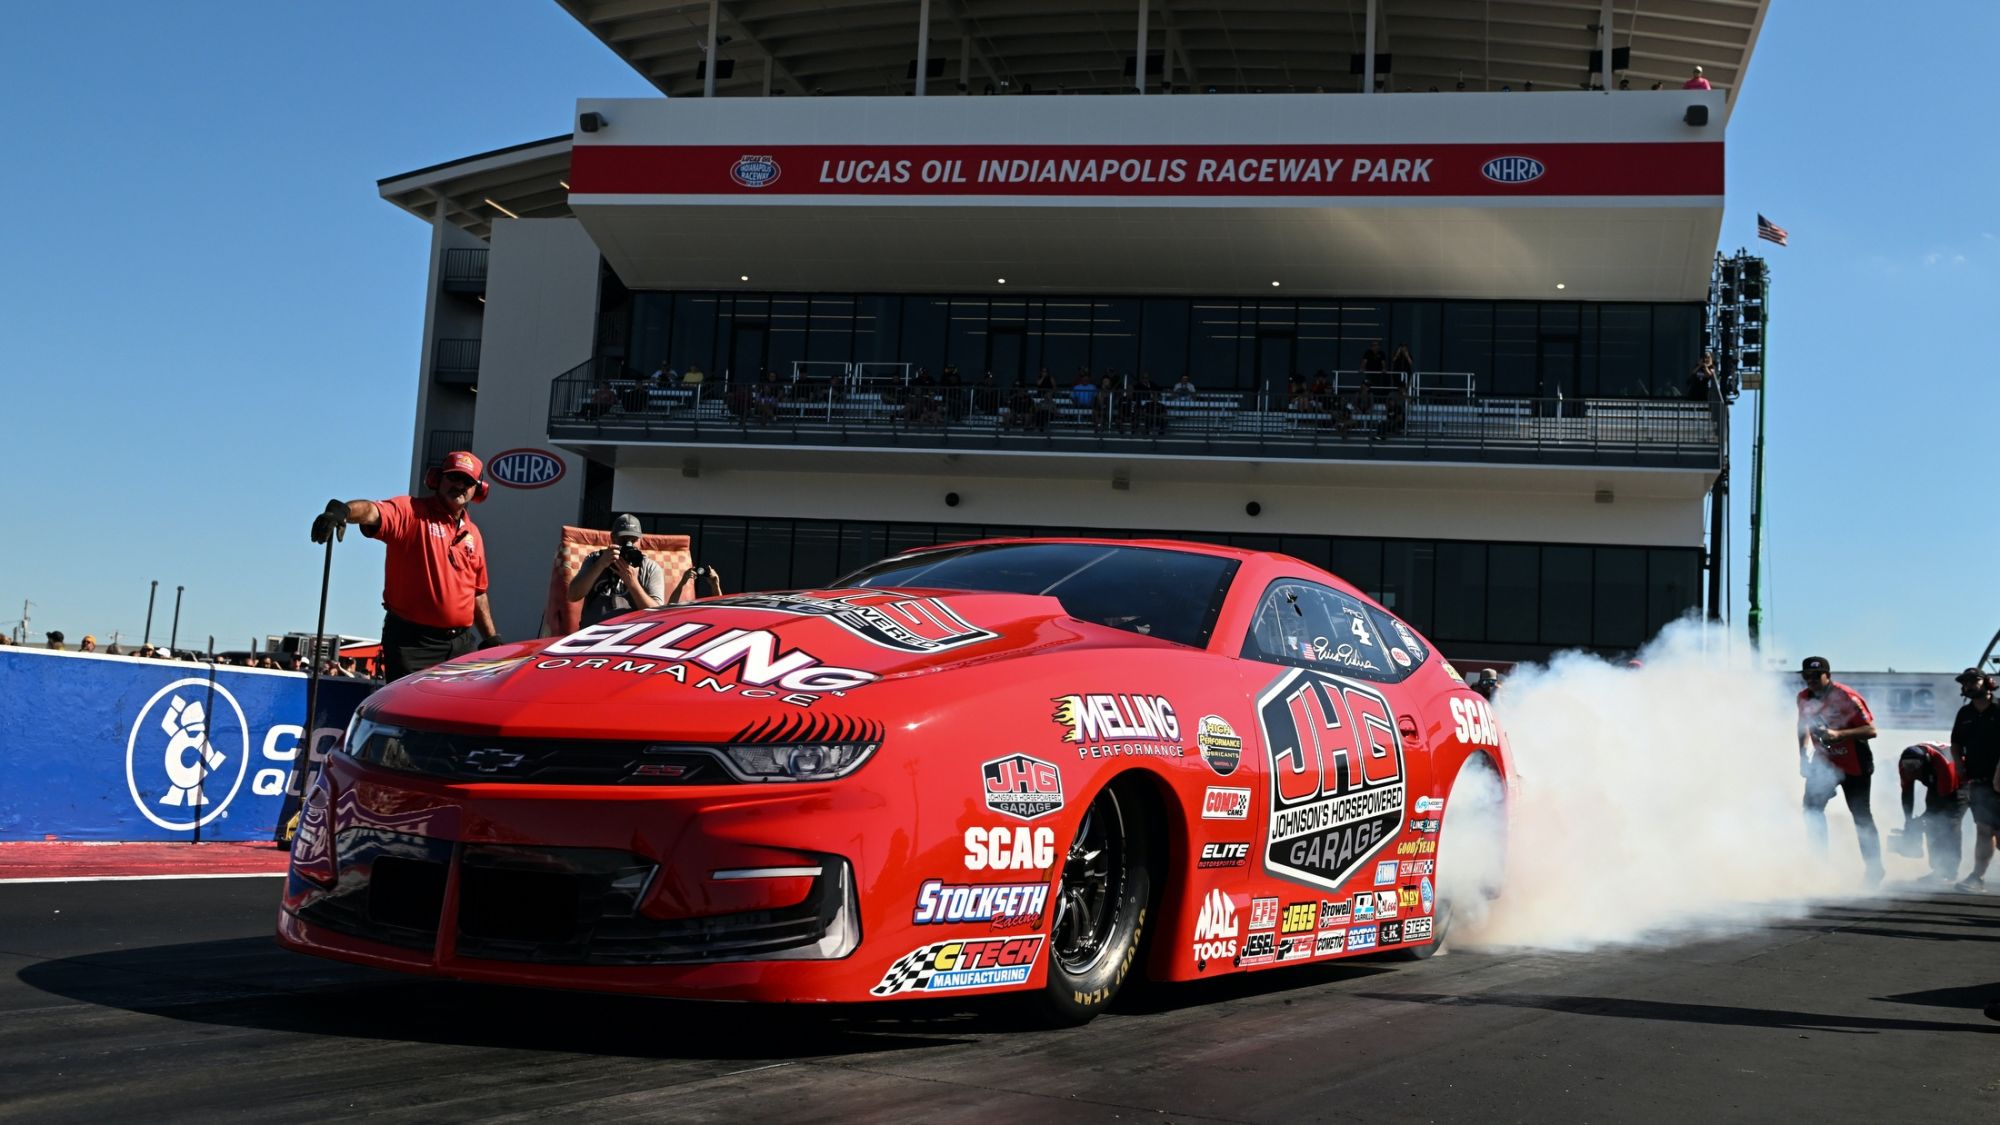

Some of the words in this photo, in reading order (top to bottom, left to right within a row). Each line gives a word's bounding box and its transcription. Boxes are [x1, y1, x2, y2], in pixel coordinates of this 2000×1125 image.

[819, 159, 912, 184] LUCAS
[920, 159, 967, 184] OIL
[977, 158, 1187, 183] INDIANAPOLIS
[1196, 157, 1344, 183] RACEWAY
[1351, 157, 1434, 183] PARK
[1487, 161, 1541, 179] NHRA
[499, 455, 555, 482] NHRA
[1351, 618, 1373, 647] 4
[543, 621, 882, 692] ELLING
[1074, 694, 1181, 743] MELLING
[1206, 723, 1231, 735] HIGH
[1078, 743, 1185, 760] PERFORMANCE
[1200, 734, 1241, 748] PERFORMANCE
[1275, 681, 1400, 805] JHG
[986, 759, 1059, 793] JHG
[1000, 803, 1052, 815] GARAGE
[1020, 794, 1062, 802] HORSEPOWERED
[1206, 791, 1239, 813] COMP
[1272, 803, 1329, 840] JOHNSON'S
[1331, 786, 1403, 824] HORSEPOWERED
[964, 826, 1055, 871] SCAG
[1201, 844, 1250, 858] ELITE
[1290, 820, 1383, 870] GARAGE
[1397, 838, 1436, 857] GOODYEAR
[915, 881, 1049, 923] STOCKSETH
[1252, 901, 1277, 922] CFE
[1321, 900, 1352, 917] Browell
[990, 911, 1040, 932] Racing
[1194, 888, 1239, 941] MAC
[1282, 904, 1317, 933] JEGS
[1193, 939, 1237, 961] TOOLS
[1242, 933, 1274, 957] JESEL
[1317, 936, 1344, 951] COMETIC
[933, 968, 1026, 987] MANUFACTURING
